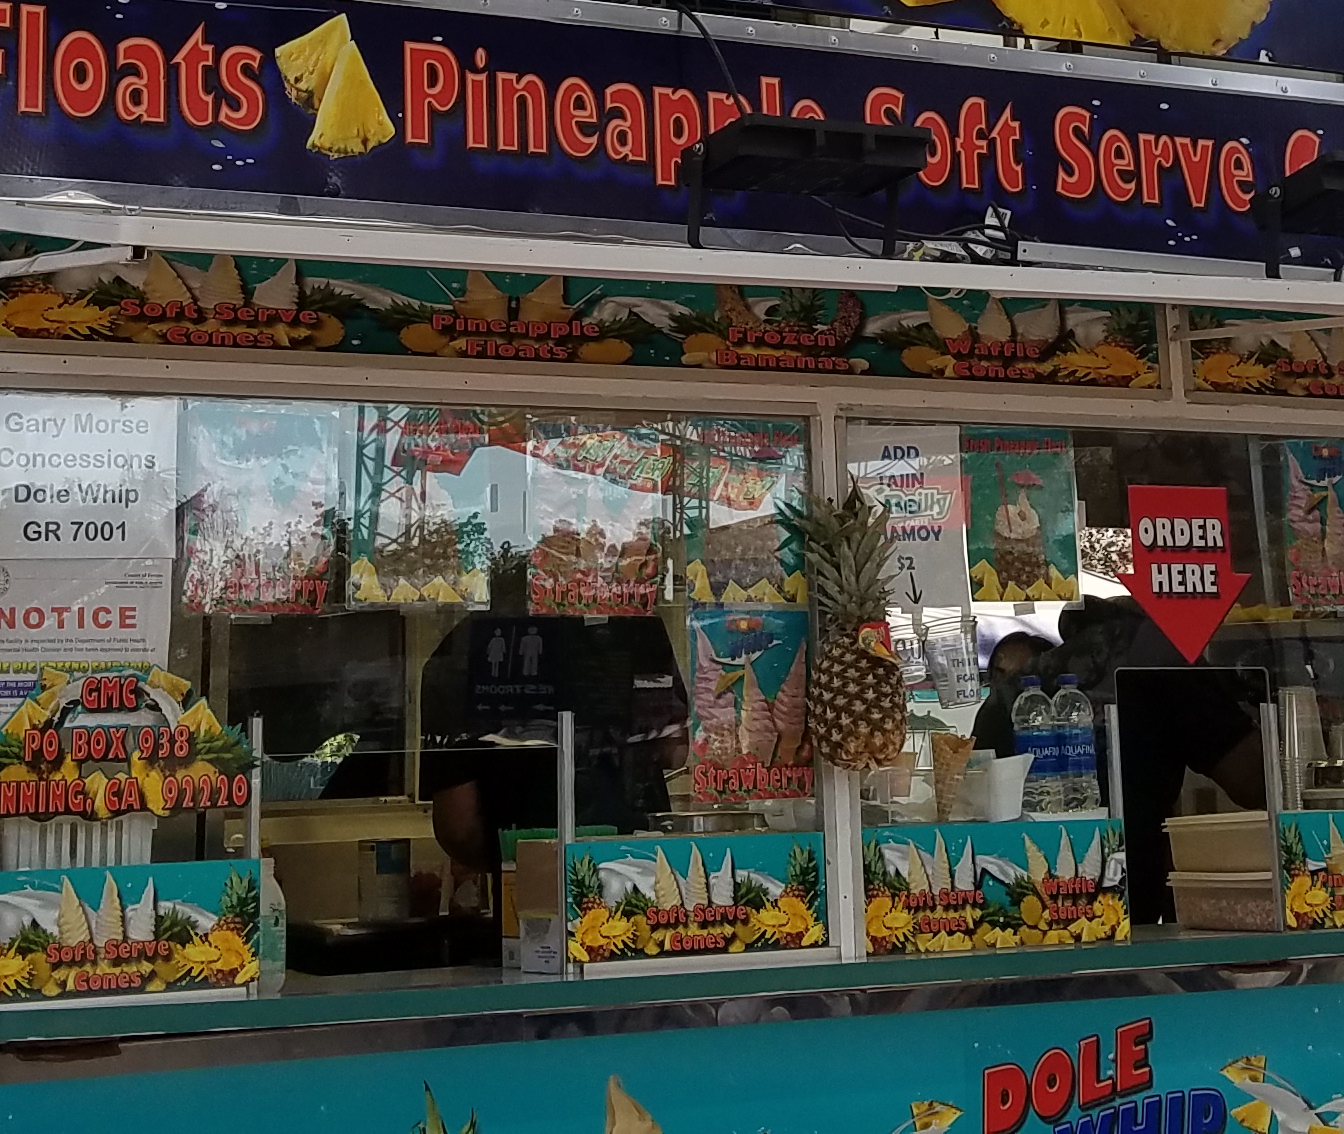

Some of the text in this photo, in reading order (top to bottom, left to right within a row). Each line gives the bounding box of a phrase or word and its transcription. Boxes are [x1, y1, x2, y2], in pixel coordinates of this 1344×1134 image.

[1056, 103, 1254, 213] Serve
[120, 298, 320, 325] Soft Serve
[166, 326, 275, 348] Cones
[432, 313, 602, 339] Pineapple
[727, 327, 837, 348] Frozen
[466, 339, 569, 360] Floats
[715, 349, 852, 371] Bananas
[943, 338, 1040, 360] Waffle
[952, 360, 1036, 381] Cones
[1276, 358, 1330, 377] Soft
[5, 412, 150, 439] Gary Morse
[880, 445, 921, 462] ADD
[14, 483, 140, 509] Dole Whip
[23, 520, 128, 543] GR 7001
[1138, 516, 1224, 548] ORDER
[896, 554, 916, 572] $2
[1150, 563, 1219, 595] HERE
[82, 676, 138, 710] GMC
[23, 725, 191, 762] PO BOX 938
[693, 762, 814, 793] Strawberry
[105, 777, 141, 811] CA
[162, 773, 249, 810] 92220
[1043, 876, 1096, 895] Waffle
[899, 887, 985, 909] Soft Serve
[646, 903, 748, 925] Soft Serve
[1049, 902, 1093, 921] Cones
[919, 915, 967, 933] Cones
[46, 939, 170, 964] Soft Serve
[670, 931, 726, 951] Cones
[74, 970, 142, 991] Cones
[982, 1016, 1153, 1134] DOLE
